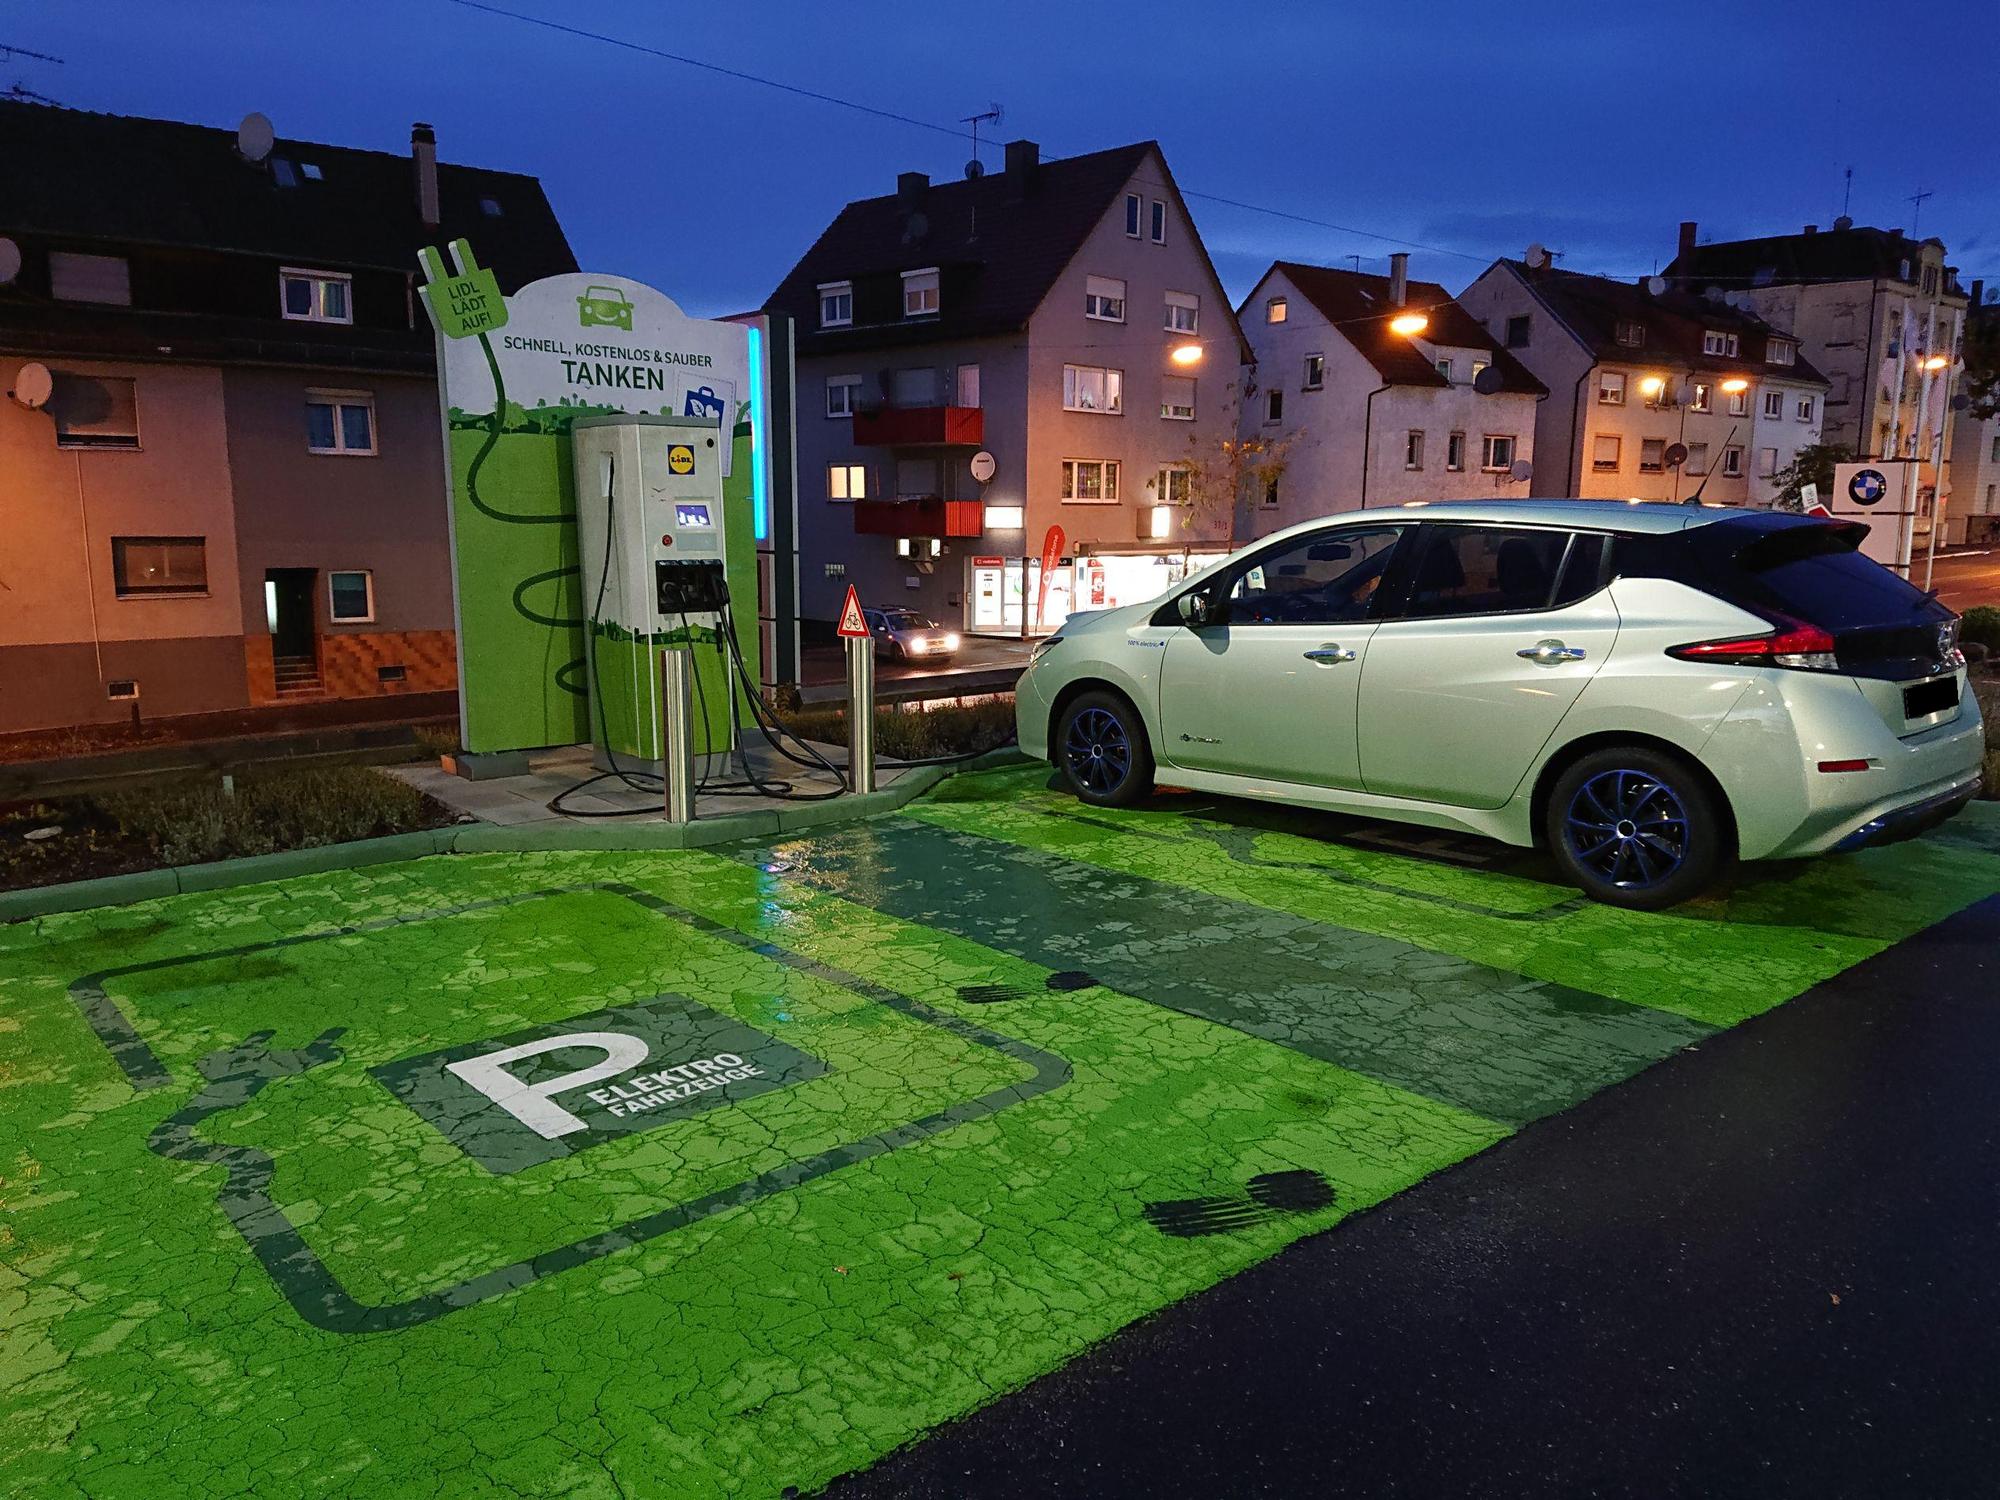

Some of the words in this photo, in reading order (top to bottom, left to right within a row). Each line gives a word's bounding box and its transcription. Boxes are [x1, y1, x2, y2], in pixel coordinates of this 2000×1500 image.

[447, 281, 481, 299] LIDL
[451, 294, 487, 316] LÄDT
[461, 311, 493, 331] AUF!
[503, 335, 572, 357] SCHNELL,
[575, 342, 652, 362] KOSTENLOS
[653, 349, 663, 363] &
[664, 351, 713, 368] SAUBER
[560, 359, 665, 391] TANKEN
[1047, 534, 1059, 571] vodafone
[444, 1032, 650, 1140] P
[586, 1053, 744, 1106] ELEKTRO
[607, 1064, 765, 1118] FAHRZEUGE
